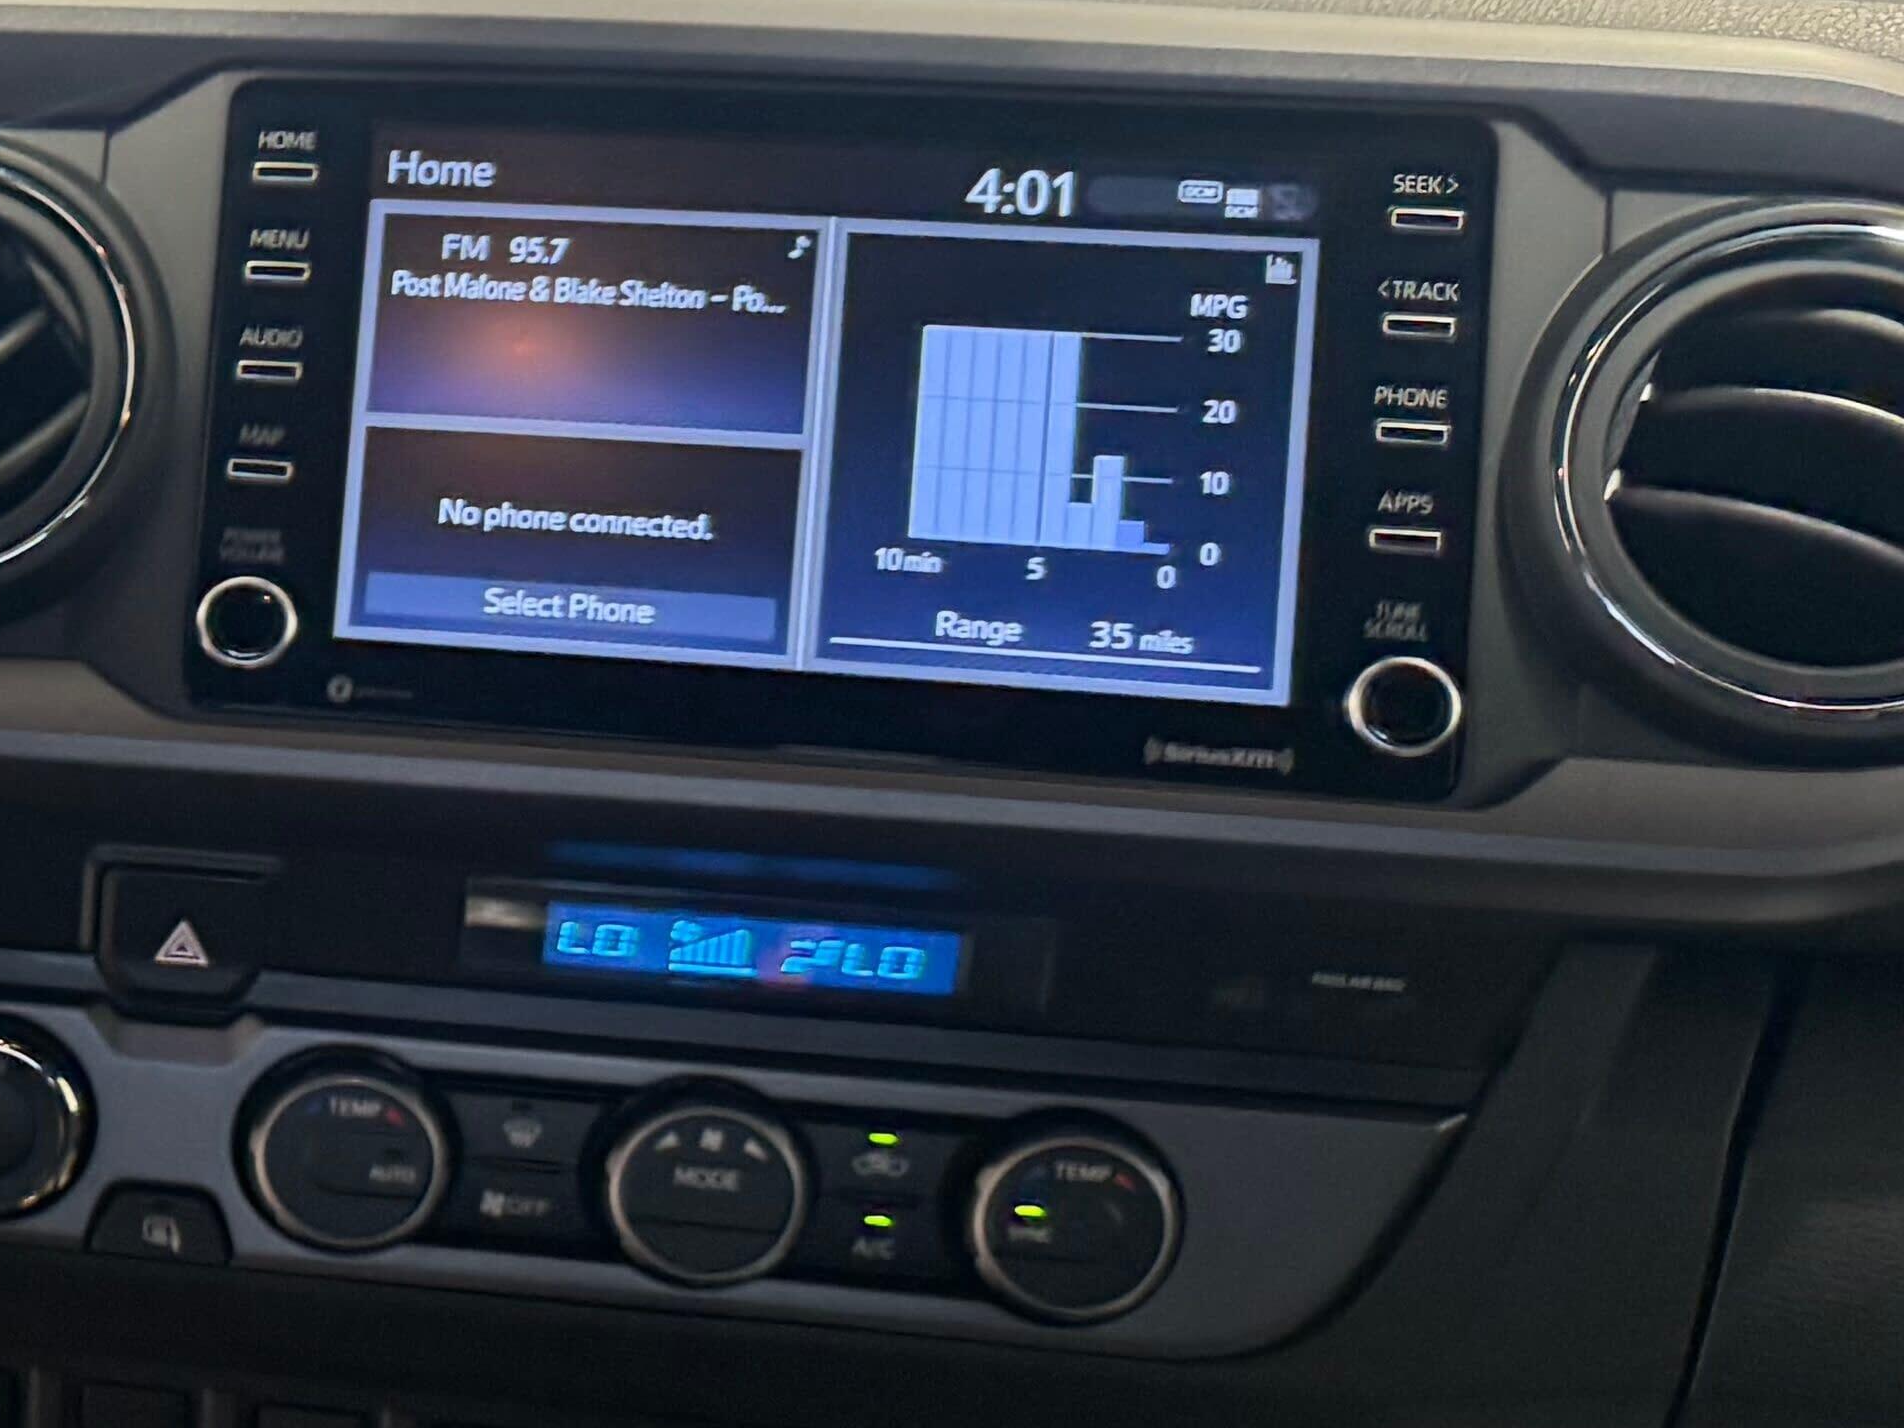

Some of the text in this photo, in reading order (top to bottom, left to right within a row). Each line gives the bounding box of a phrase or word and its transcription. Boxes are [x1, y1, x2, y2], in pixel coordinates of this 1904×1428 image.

[258, 130, 318, 151] HOME
[386, 149, 497, 188] Home
[964, 168, 1075, 218] 4:01
[249, 228, 310, 250] MENU
[441, 233, 571, 265] FM 95.7
[392, 269, 440, 299] Post
[443, 272, 527, 302] Malone
[528, 275, 551, 303] &
[553, 276, 618, 306] Blake
[619, 279, 706, 310] Shelton
[1393, 279, 1460, 301] TRACK
[1190, 292, 1248, 320] MPG
[240, 326, 304, 349] AUDIO
[1206, 327, 1242, 354] 30
[1374, 385, 1448, 409] PHONE
[1202, 399, 1237, 425] 20
[1200, 470, 1230, 496] 10
[1378, 487, 1434, 515] APPS
[437, 497, 714, 541] No phone connected.
[874, 547, 904, 572] 10
[1199, 541, 1221, 567] 0
[1025, 556, 1047, 581] 5
[1155, 565, 1177, 590] 0
[483, 586, 657, 625] Select Phone
[935, 610, 1194, 654] Range 35 miles
[672, 1166, 741, 1192] MODE
